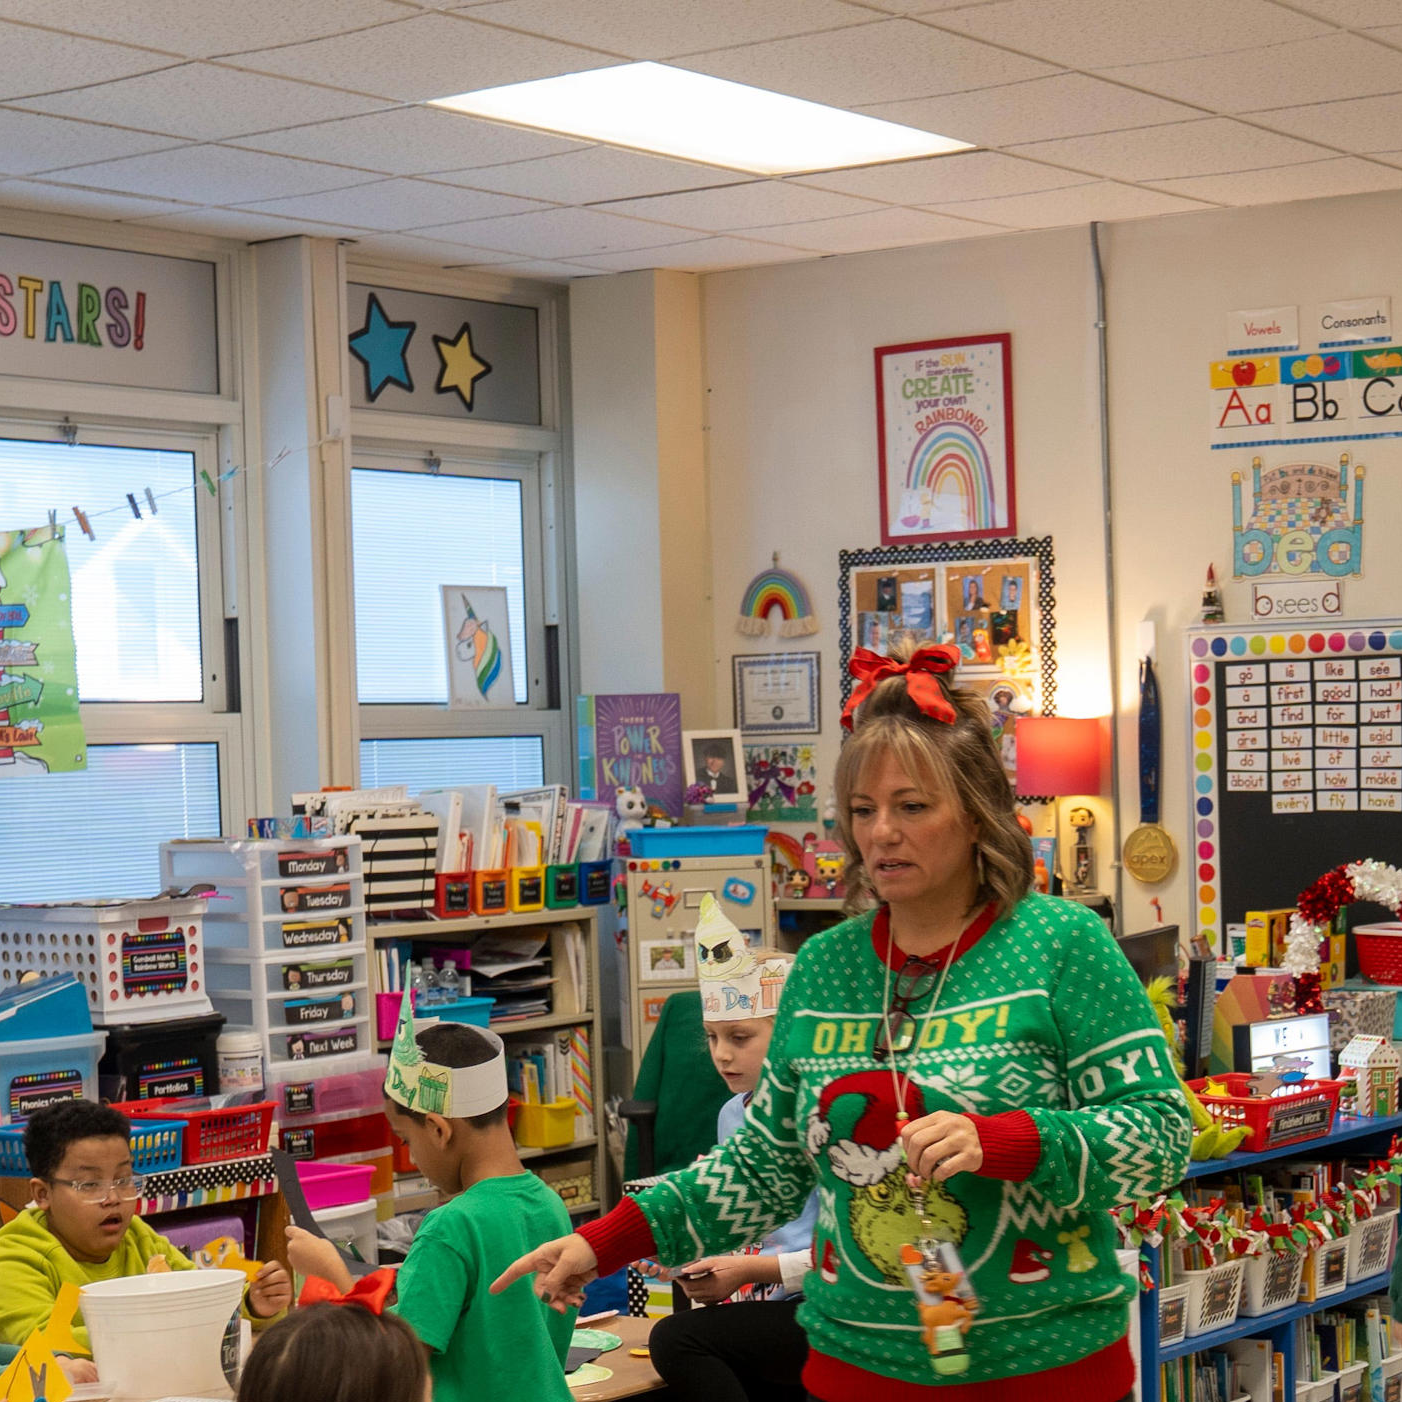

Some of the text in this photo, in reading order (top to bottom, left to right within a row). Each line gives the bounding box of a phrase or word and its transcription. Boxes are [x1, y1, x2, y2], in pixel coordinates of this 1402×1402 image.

[1244, 321, 1281, 337] Vowels
[1321, 312, 1387, 330] Consonants
[915, 353, 966, 371] IF the SUN
[902, 374, 974, 400] CREATE
[915, 396, 967, 413] your own
[1219, 390, 1272, 428] Aa
[914, 408, 988, 436] RAINBOWS!
[1233, 485, 1363, 577] bed
[1254, 582, 1341, 616] b sees d
[1325, 659, 1344, 677] like
[1323, 686, 1351, 702] good
[613, 725, 664, 755] POWER
[1323, 730, 1349, 743] little
[602, 755, 676, 788] KINDNESS
[1276, 797, 1309, 809] every
[288, 862, 326, 874] Monday
[1131, 854, 1166, 866] apex
[306, 893, 344, 907] Tuesday
[284, 932, 338, 945] Wednesday
[307, 970, 348, 984] Thursday
[722, 987, 759, 1015] Day
[300, 1006, 329, 1019] Friday
[309, 1037, 354, 1054] Next Week
[812, 1022, 871, 1055] OH
[154, 1083, 189, 1096] Portfolios
